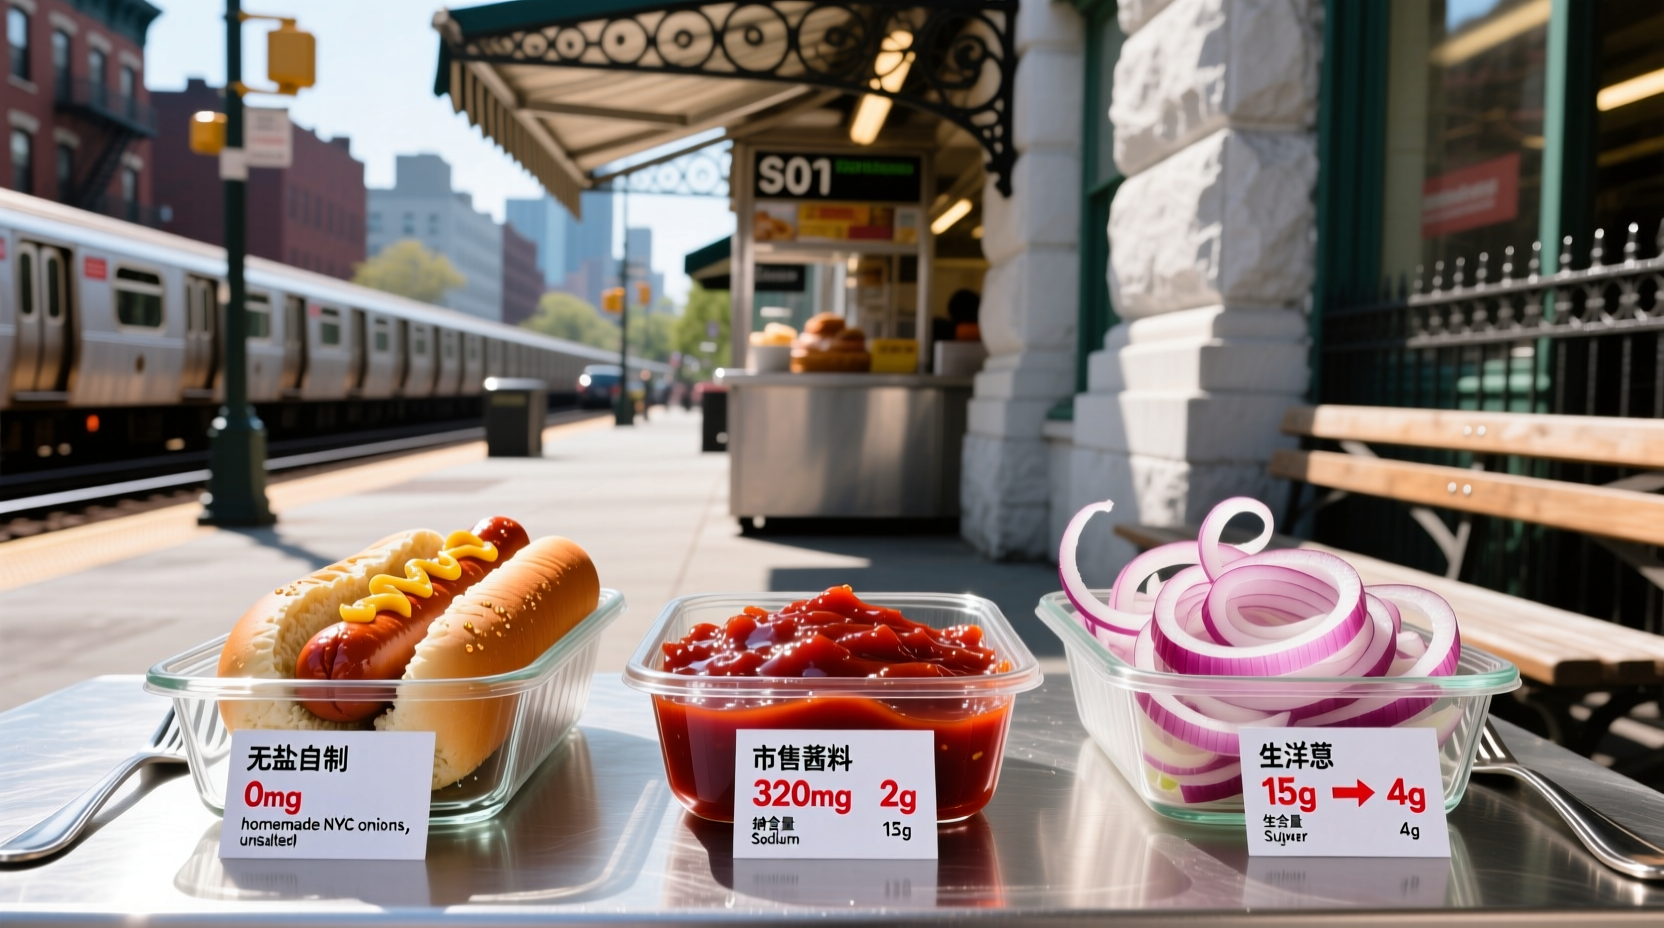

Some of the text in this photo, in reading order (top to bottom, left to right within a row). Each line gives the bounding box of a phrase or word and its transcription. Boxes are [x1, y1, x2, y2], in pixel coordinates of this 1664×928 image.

[758, 156, 832, 196] S01
[246, 743, 349, 773] 无盐自制
[244, 780, 302, 815] 0mg
[752, 778, 917, 815] 320mg 2g
[1261, 776, 1426, 814] 15g 4g
[241, 816, 410, 835] homemade NYC onions,
[882, 821, 912, 841] 15g
[1399, 822, 1420, 840] 4g
